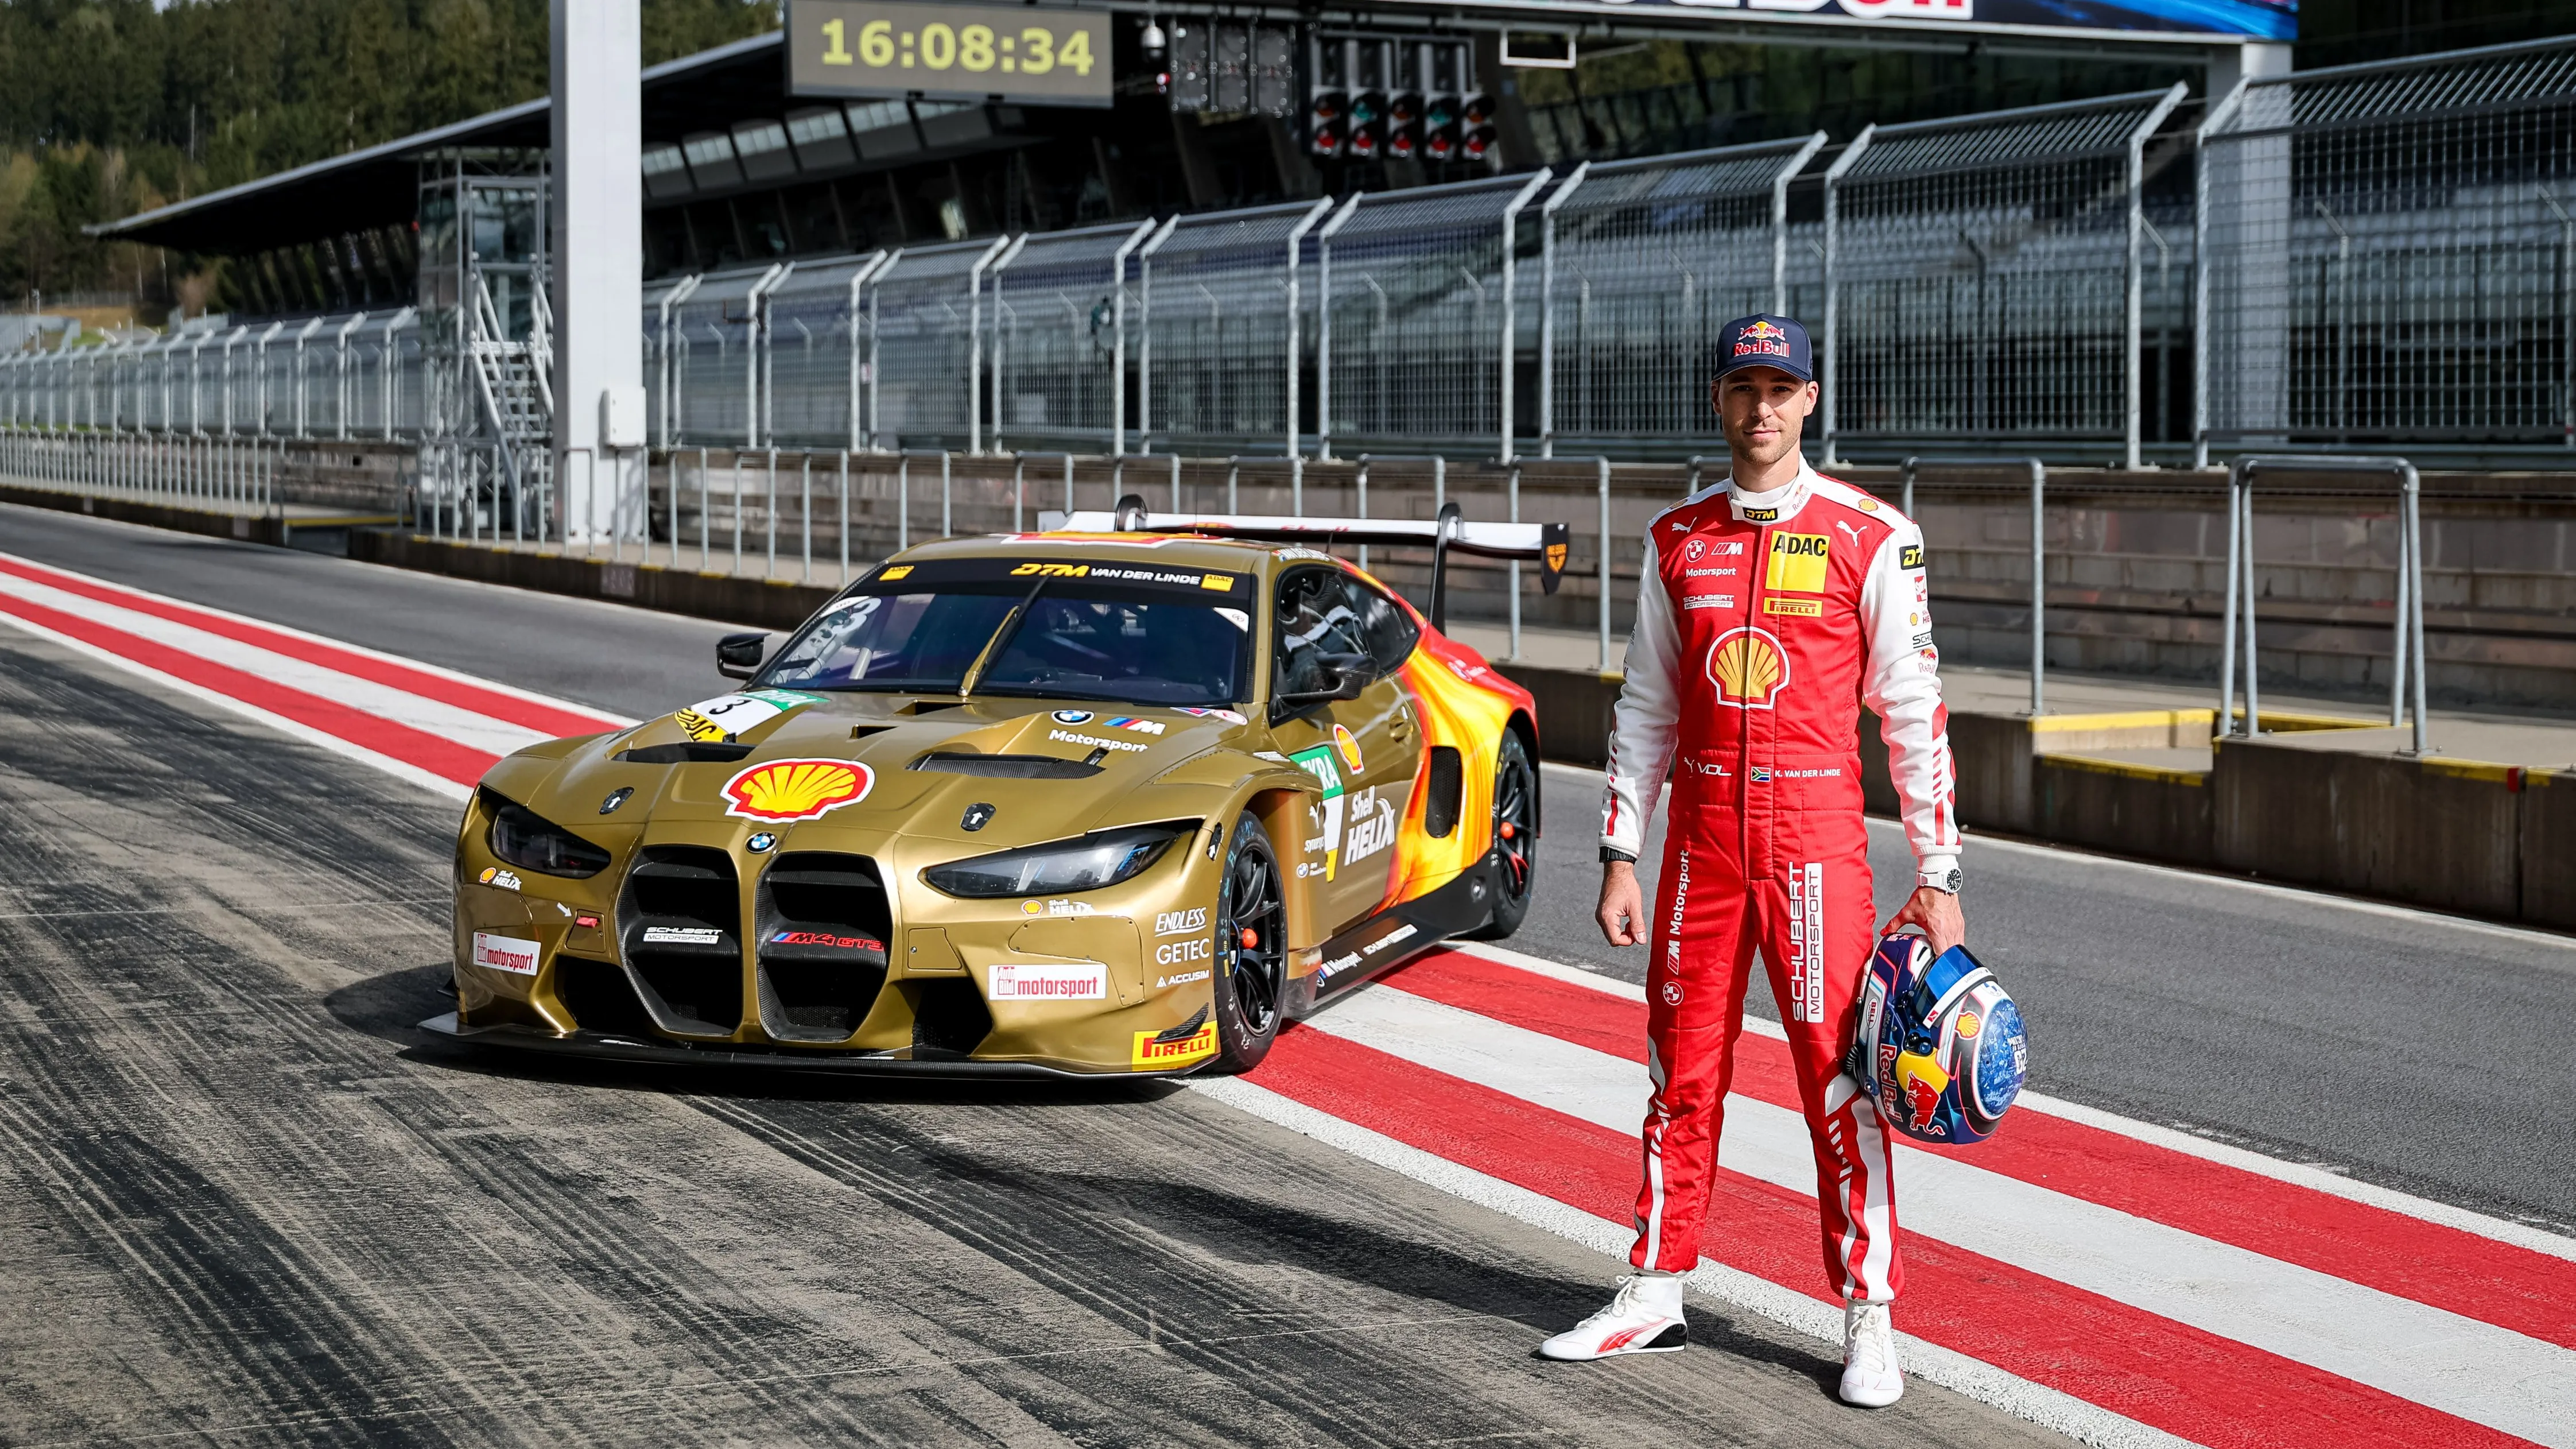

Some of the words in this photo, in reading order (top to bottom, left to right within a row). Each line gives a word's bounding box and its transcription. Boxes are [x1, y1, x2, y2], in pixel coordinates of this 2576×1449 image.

[821, 18, 1095, 76] 16:08:34
[1734, 339, 1762, 357] Red
[1762, 340, 1790, 358] Bull
[1746, 510, 1775, 520] DTM
[1773, 534, 1826, 557] ADAC
[1010, 563, 1090, 578] DTM
[1091, 568, 1120, 579] VAN
[1121, 569, 1154, 581] DER
[1154, 573, 1201, 585] LINDE
[1207, 575, 1232, 583] ADAC
[1686, 567, 1737, 578] Motorsport
[1683, 594, 1735, 603] SCHUBERT
[1769, 600, 1817, 614] PIRELLI
[709, 699, 752, 715] 3
[1048, 729, 1149, 753] Motorsport
[1784, 769, 1801, 777] VAN
[1802, 769, 1818, 777] DER
[1819, 768, 1841, 777] LINDE
[1350, 784, 1376, 823] Shell
[1344, 797, 1396, 866] HELIX
[492, 875, 522, 890] HELIX
[1670, 850, 1691, 936] Motorsport
[1048, 901, 1096, 915] HELIX
[1155, 906, 1206, 932] ENDLESS
[646, 927, 723, 935] SCHUBERT
[790, 932, 835, 946] M4
[1155, 937, 1210, 965] GETEC
[1789, 861, 1805, 1022] SCHUBERT
[1809, 870, 1820, 1014] MOTORSPORT
[487, 948, 533, 971] motorsport
[998, 967, 1015, 980] Auto
[1168, 969, 1209, 985] ACCUSIM
[998, 980, 1015, 995] Bild
[1018, 977, 1097, 998] motorsport
[1142, 1028, 1211, 1058] PIRELLI
[1880, 1043, 1898, 1087] Red
